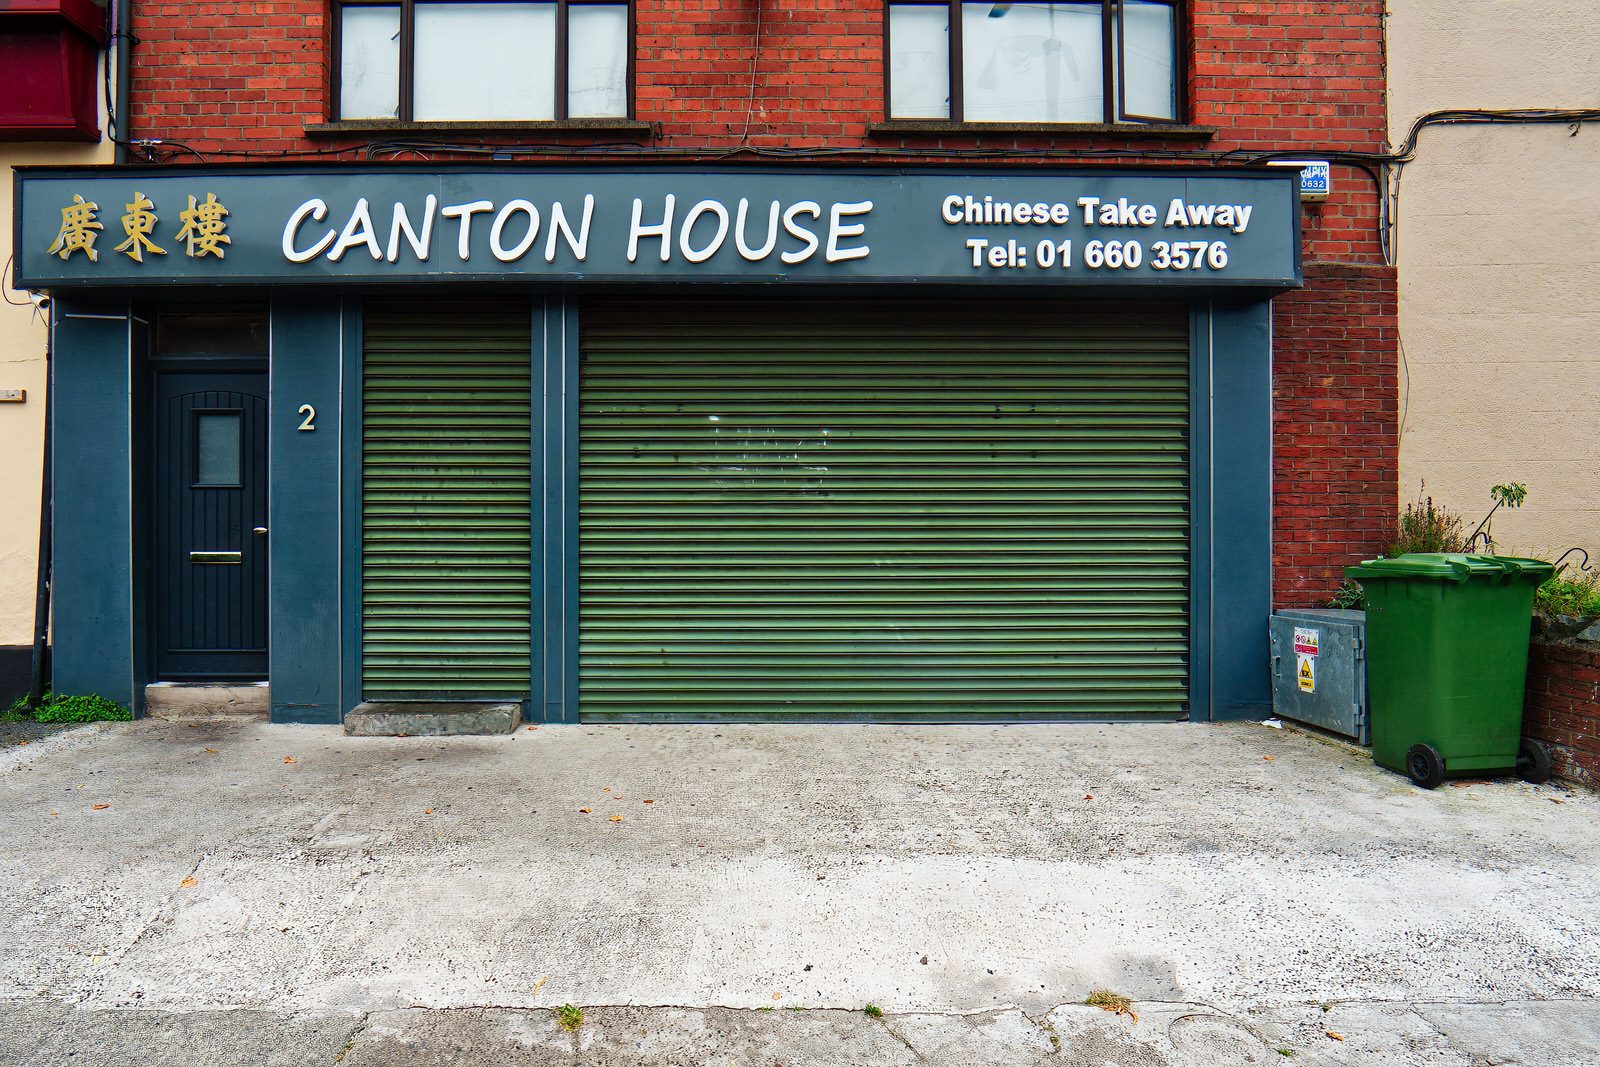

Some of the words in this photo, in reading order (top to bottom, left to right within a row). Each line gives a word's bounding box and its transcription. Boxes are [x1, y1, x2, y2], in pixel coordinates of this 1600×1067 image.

[1301, 180, 1324, 188] 0632
[47, 191, 232, 263] 廣東樓
[282, 194, 595, 264] CANTON
[626, 194, 874, 265] HOUSE
[941, 195, 1069, 226] Chinese
[1077, 197, 1157, 227] Take
[1163, 198, 1253, 234] Away
[966, 238, 1027, 269] Tel:
[1036, 239, 1072, 269] 01
[1083, 239, 1143, 269] 660
[1150, 240, 1229, 270] 3576
[297, 403, 316, 431] 2
